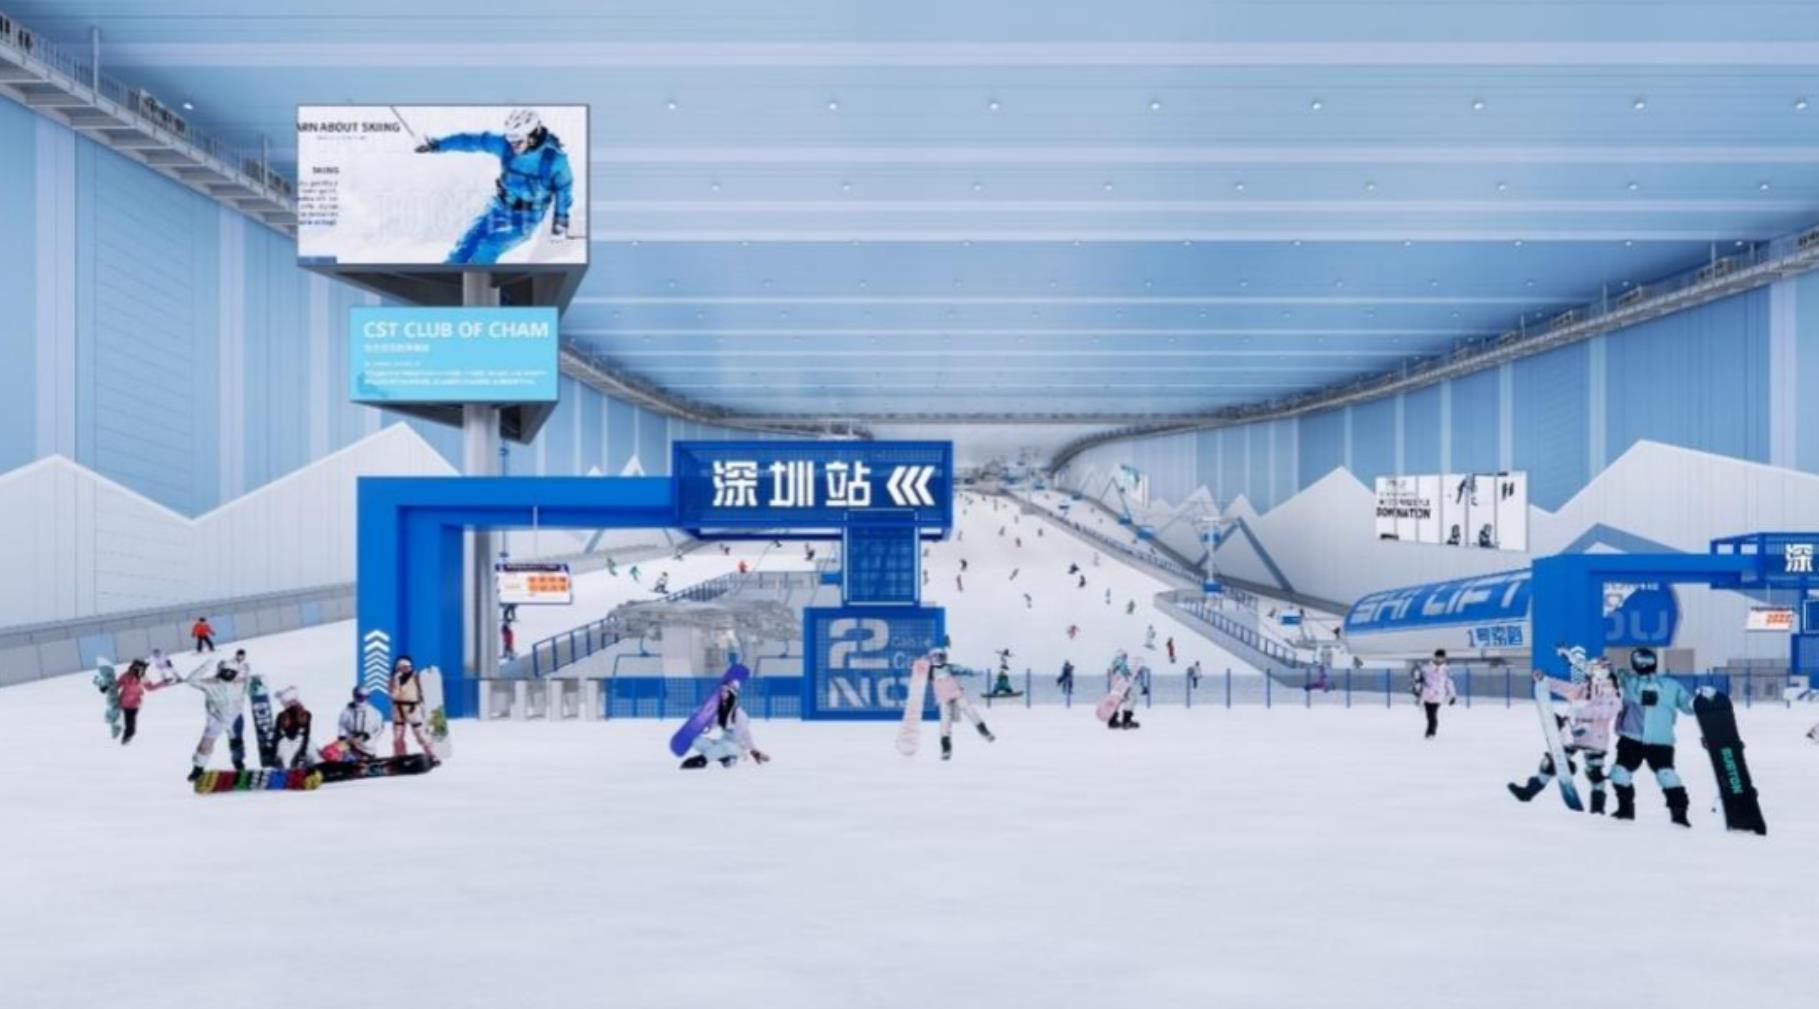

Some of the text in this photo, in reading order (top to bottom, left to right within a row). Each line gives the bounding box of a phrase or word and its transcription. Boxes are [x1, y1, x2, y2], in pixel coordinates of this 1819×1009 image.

[320, 122, 358, 133] ABOUT
[362, 122, 401, 133] SKIING
[363, 321, 549, 338] CST CLUB OF CHAM
[712, 460, 872, 507] 深圳站
[829, 618, 889, 669] 2
[1720, 747, 1744, 794] BURTON
